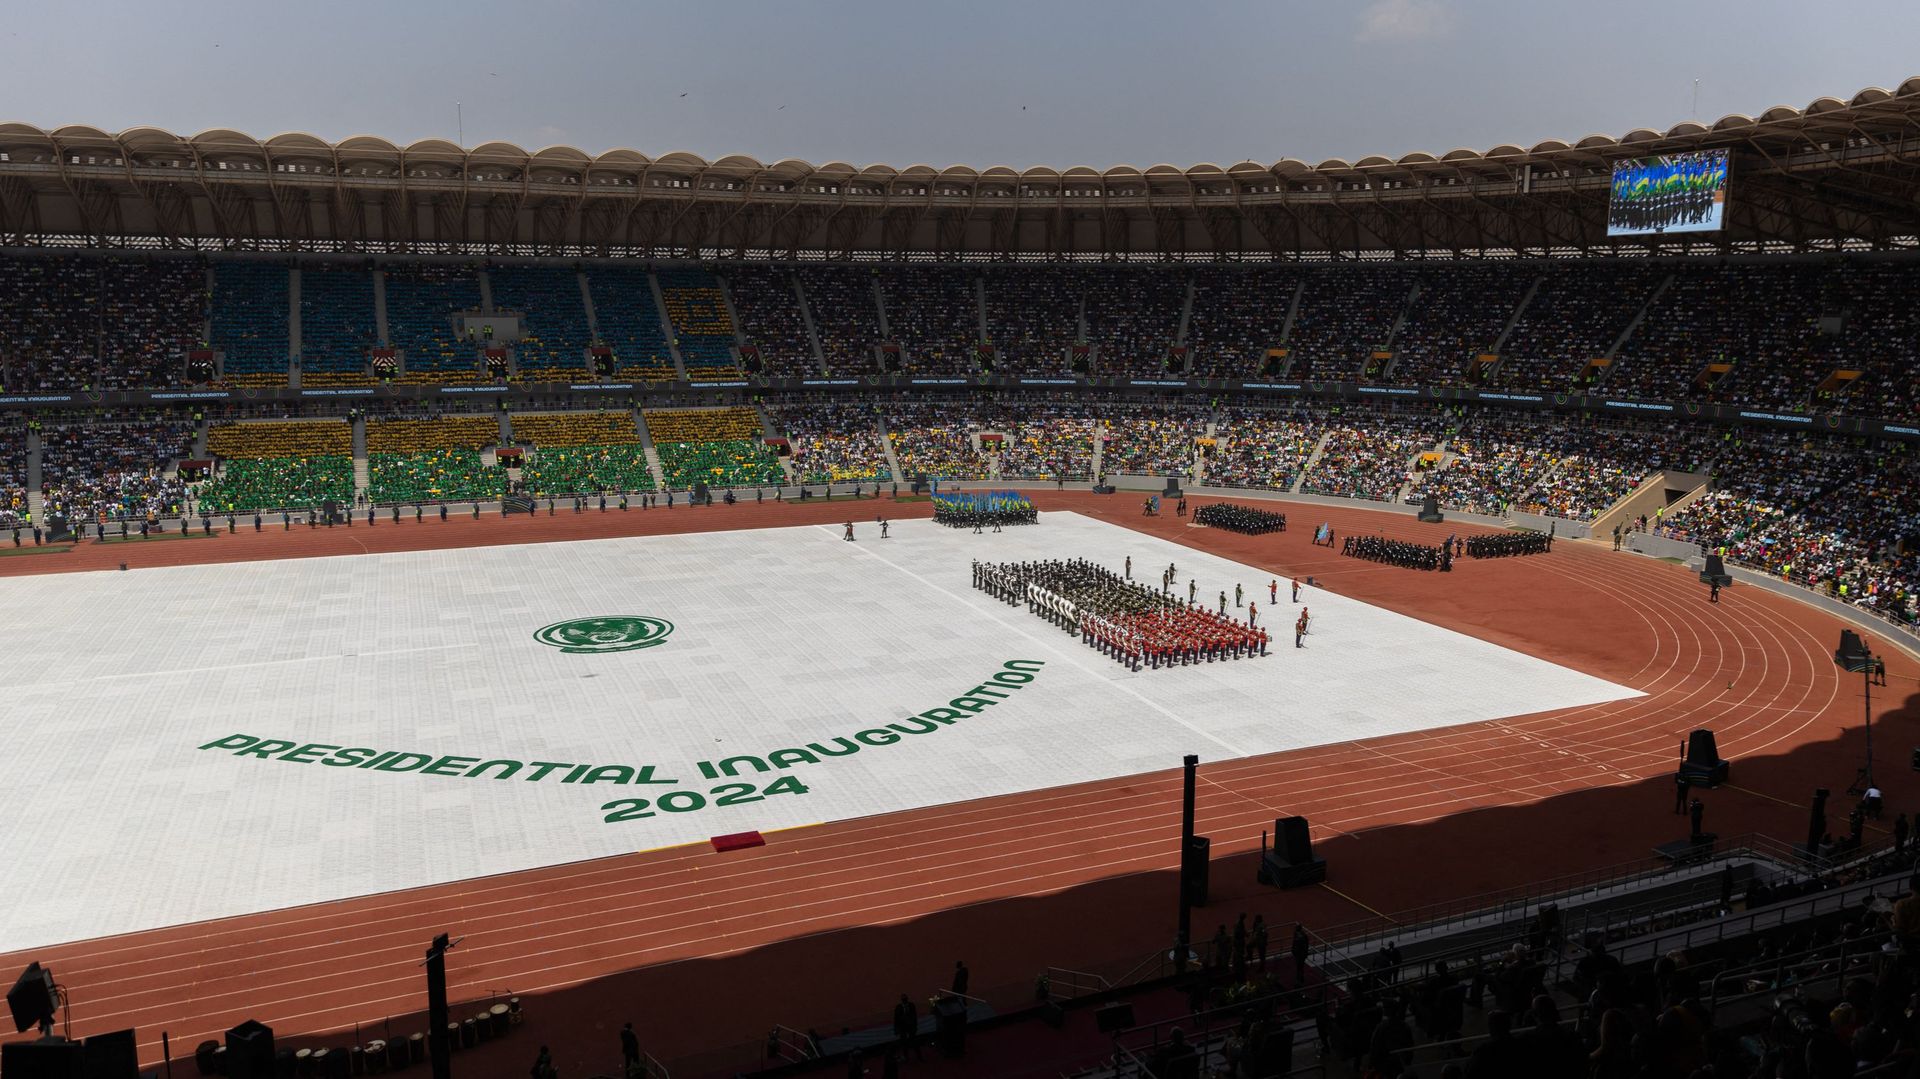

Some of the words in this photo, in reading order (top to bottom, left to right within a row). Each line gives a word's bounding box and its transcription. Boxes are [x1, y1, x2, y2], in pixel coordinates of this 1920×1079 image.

[198, 734, 678, 785] PRESIDENTIAL
[697, 660, 1045, 780] INAUGURATION
[603, 776, 810, 823] 2024
